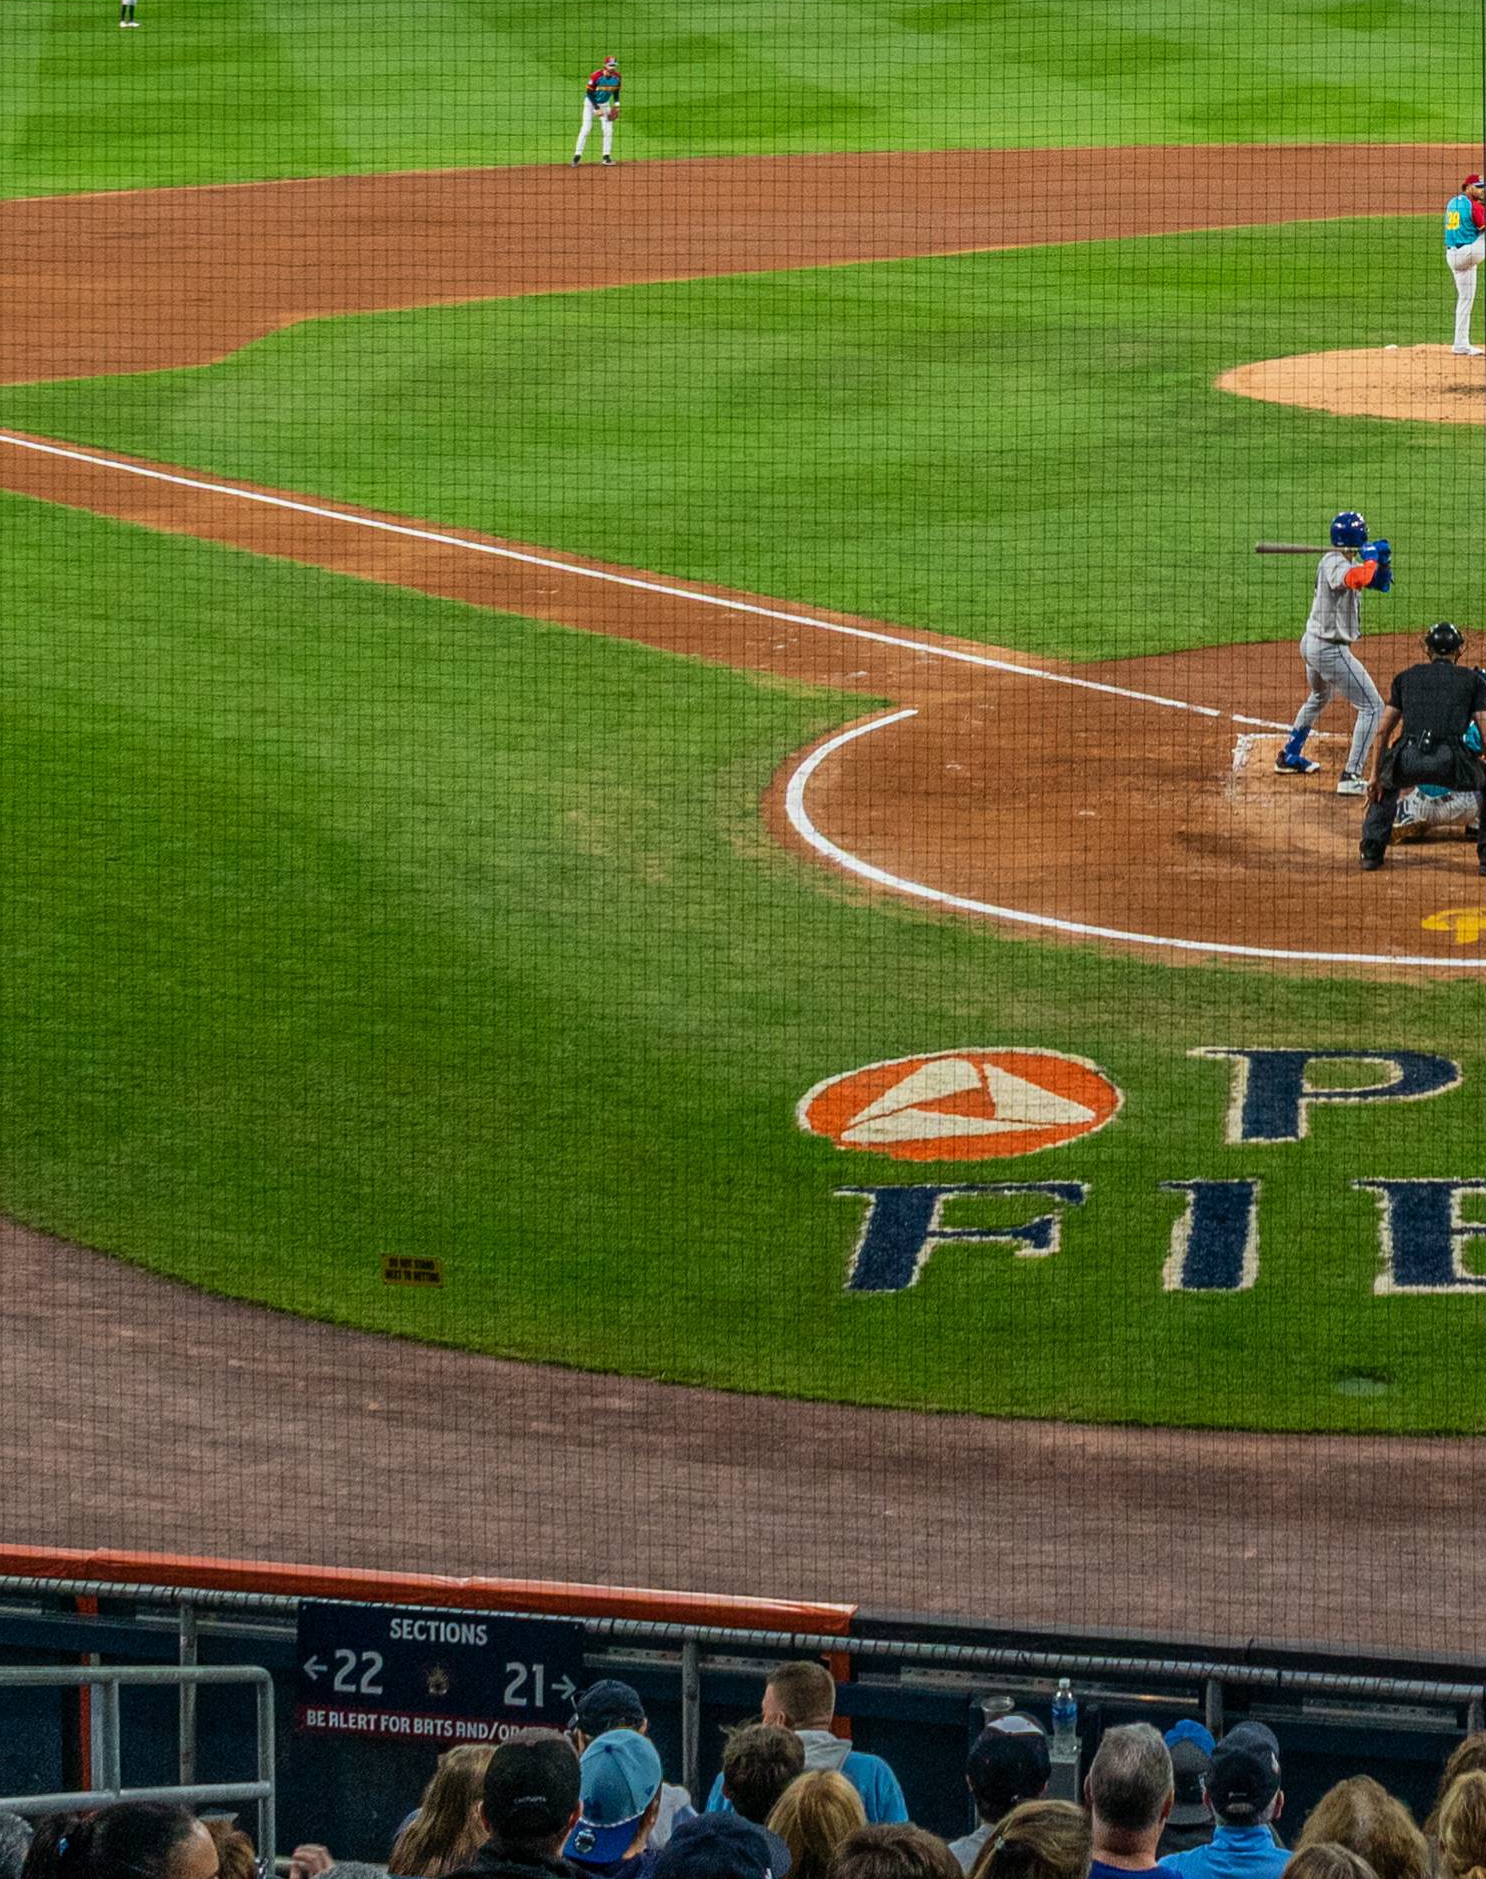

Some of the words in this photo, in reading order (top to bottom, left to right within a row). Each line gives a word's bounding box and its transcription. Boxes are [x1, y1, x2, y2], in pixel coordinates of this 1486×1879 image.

[389, 1618, 488, 1646] SECTIONS
[332, 1648, 384, 1695] 22
[503, 1661, 545, 1708] 21
[306, 1709, 326, 1727] BE
[328, 1710, 378, 1731] ALERT
[380, 1715, 411, 1734] FOR
[413, 1718, 454, 1737] BATS
